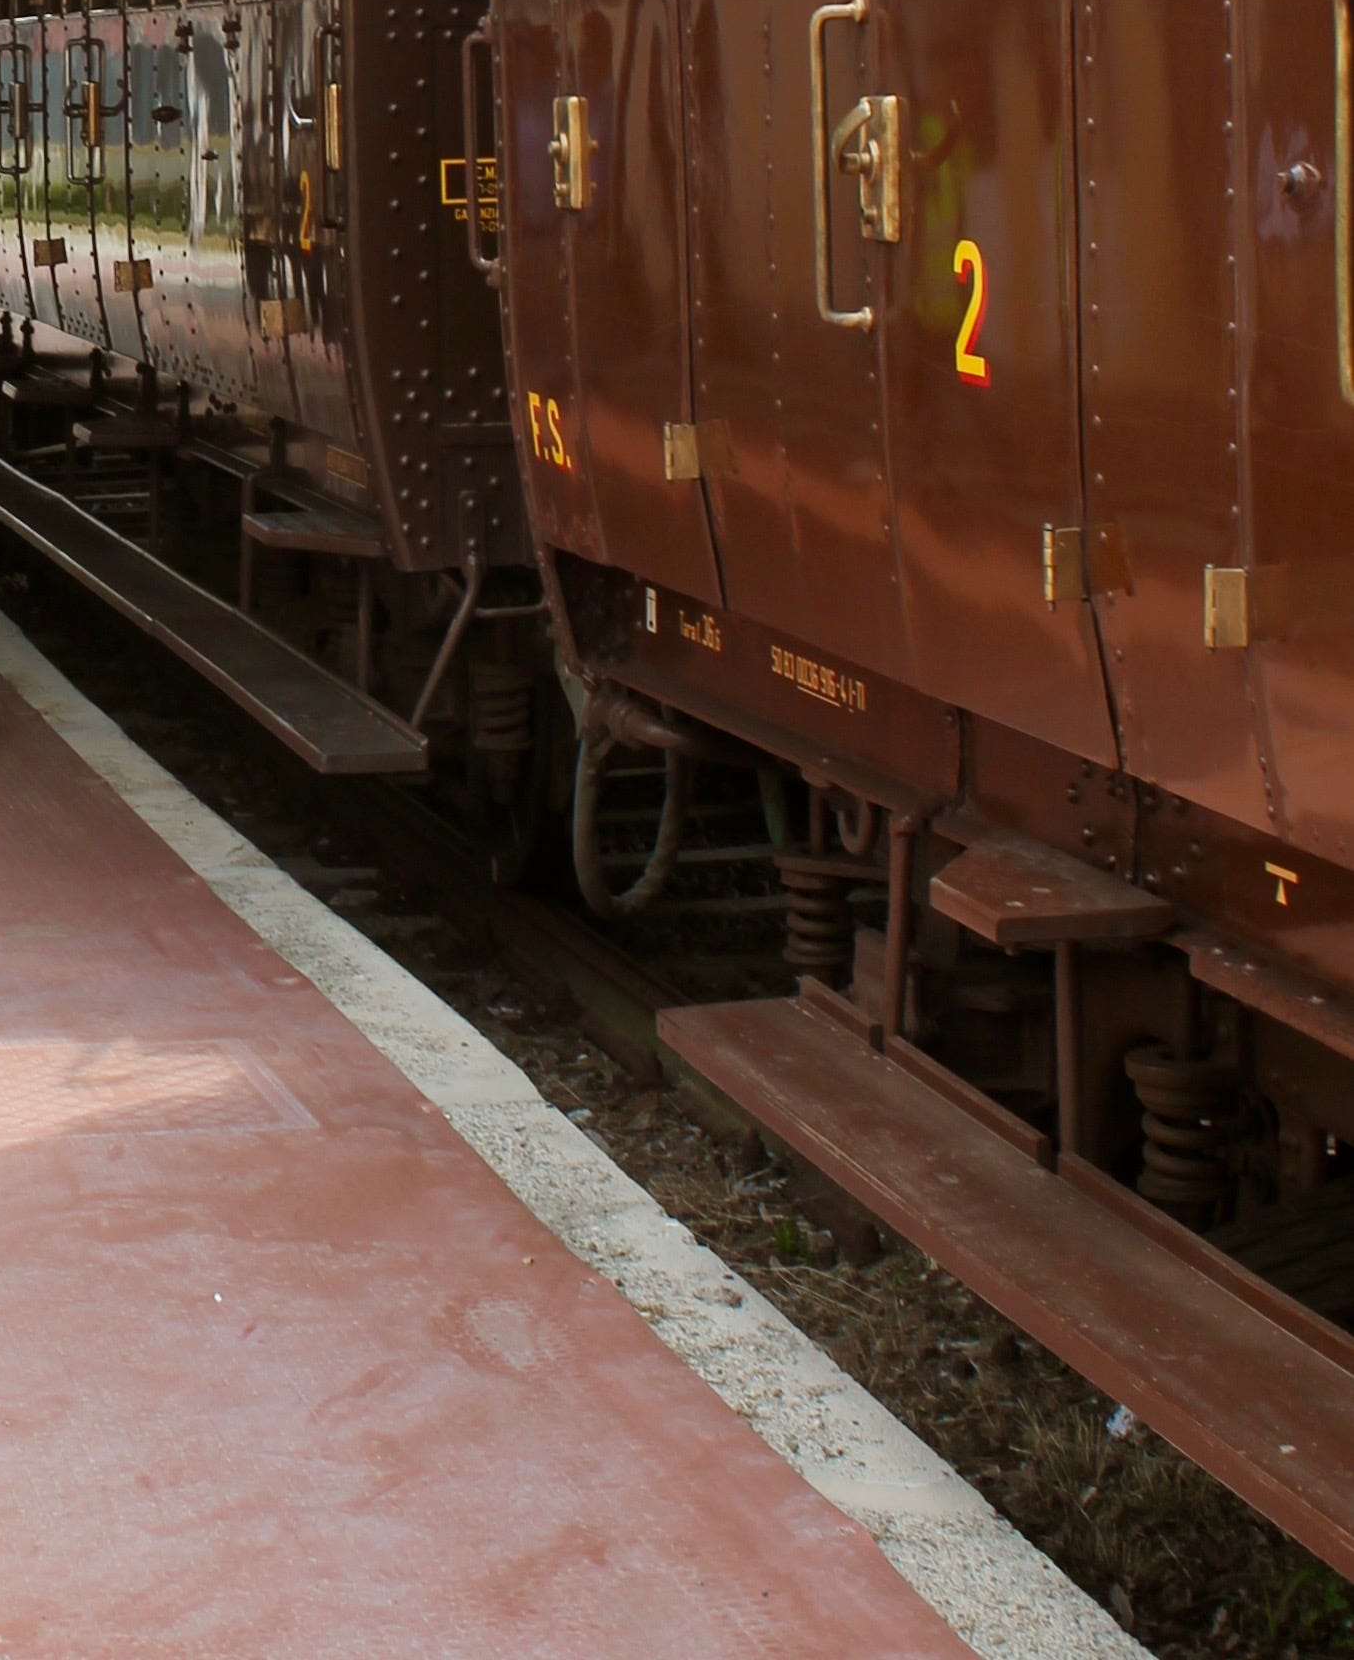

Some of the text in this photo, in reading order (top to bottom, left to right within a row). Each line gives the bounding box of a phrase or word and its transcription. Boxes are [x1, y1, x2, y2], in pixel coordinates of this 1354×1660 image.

[299, 170, 311, 251] 2
[953, 239, 989, 383] 2
[527, 390, 573, 470] F.S.
